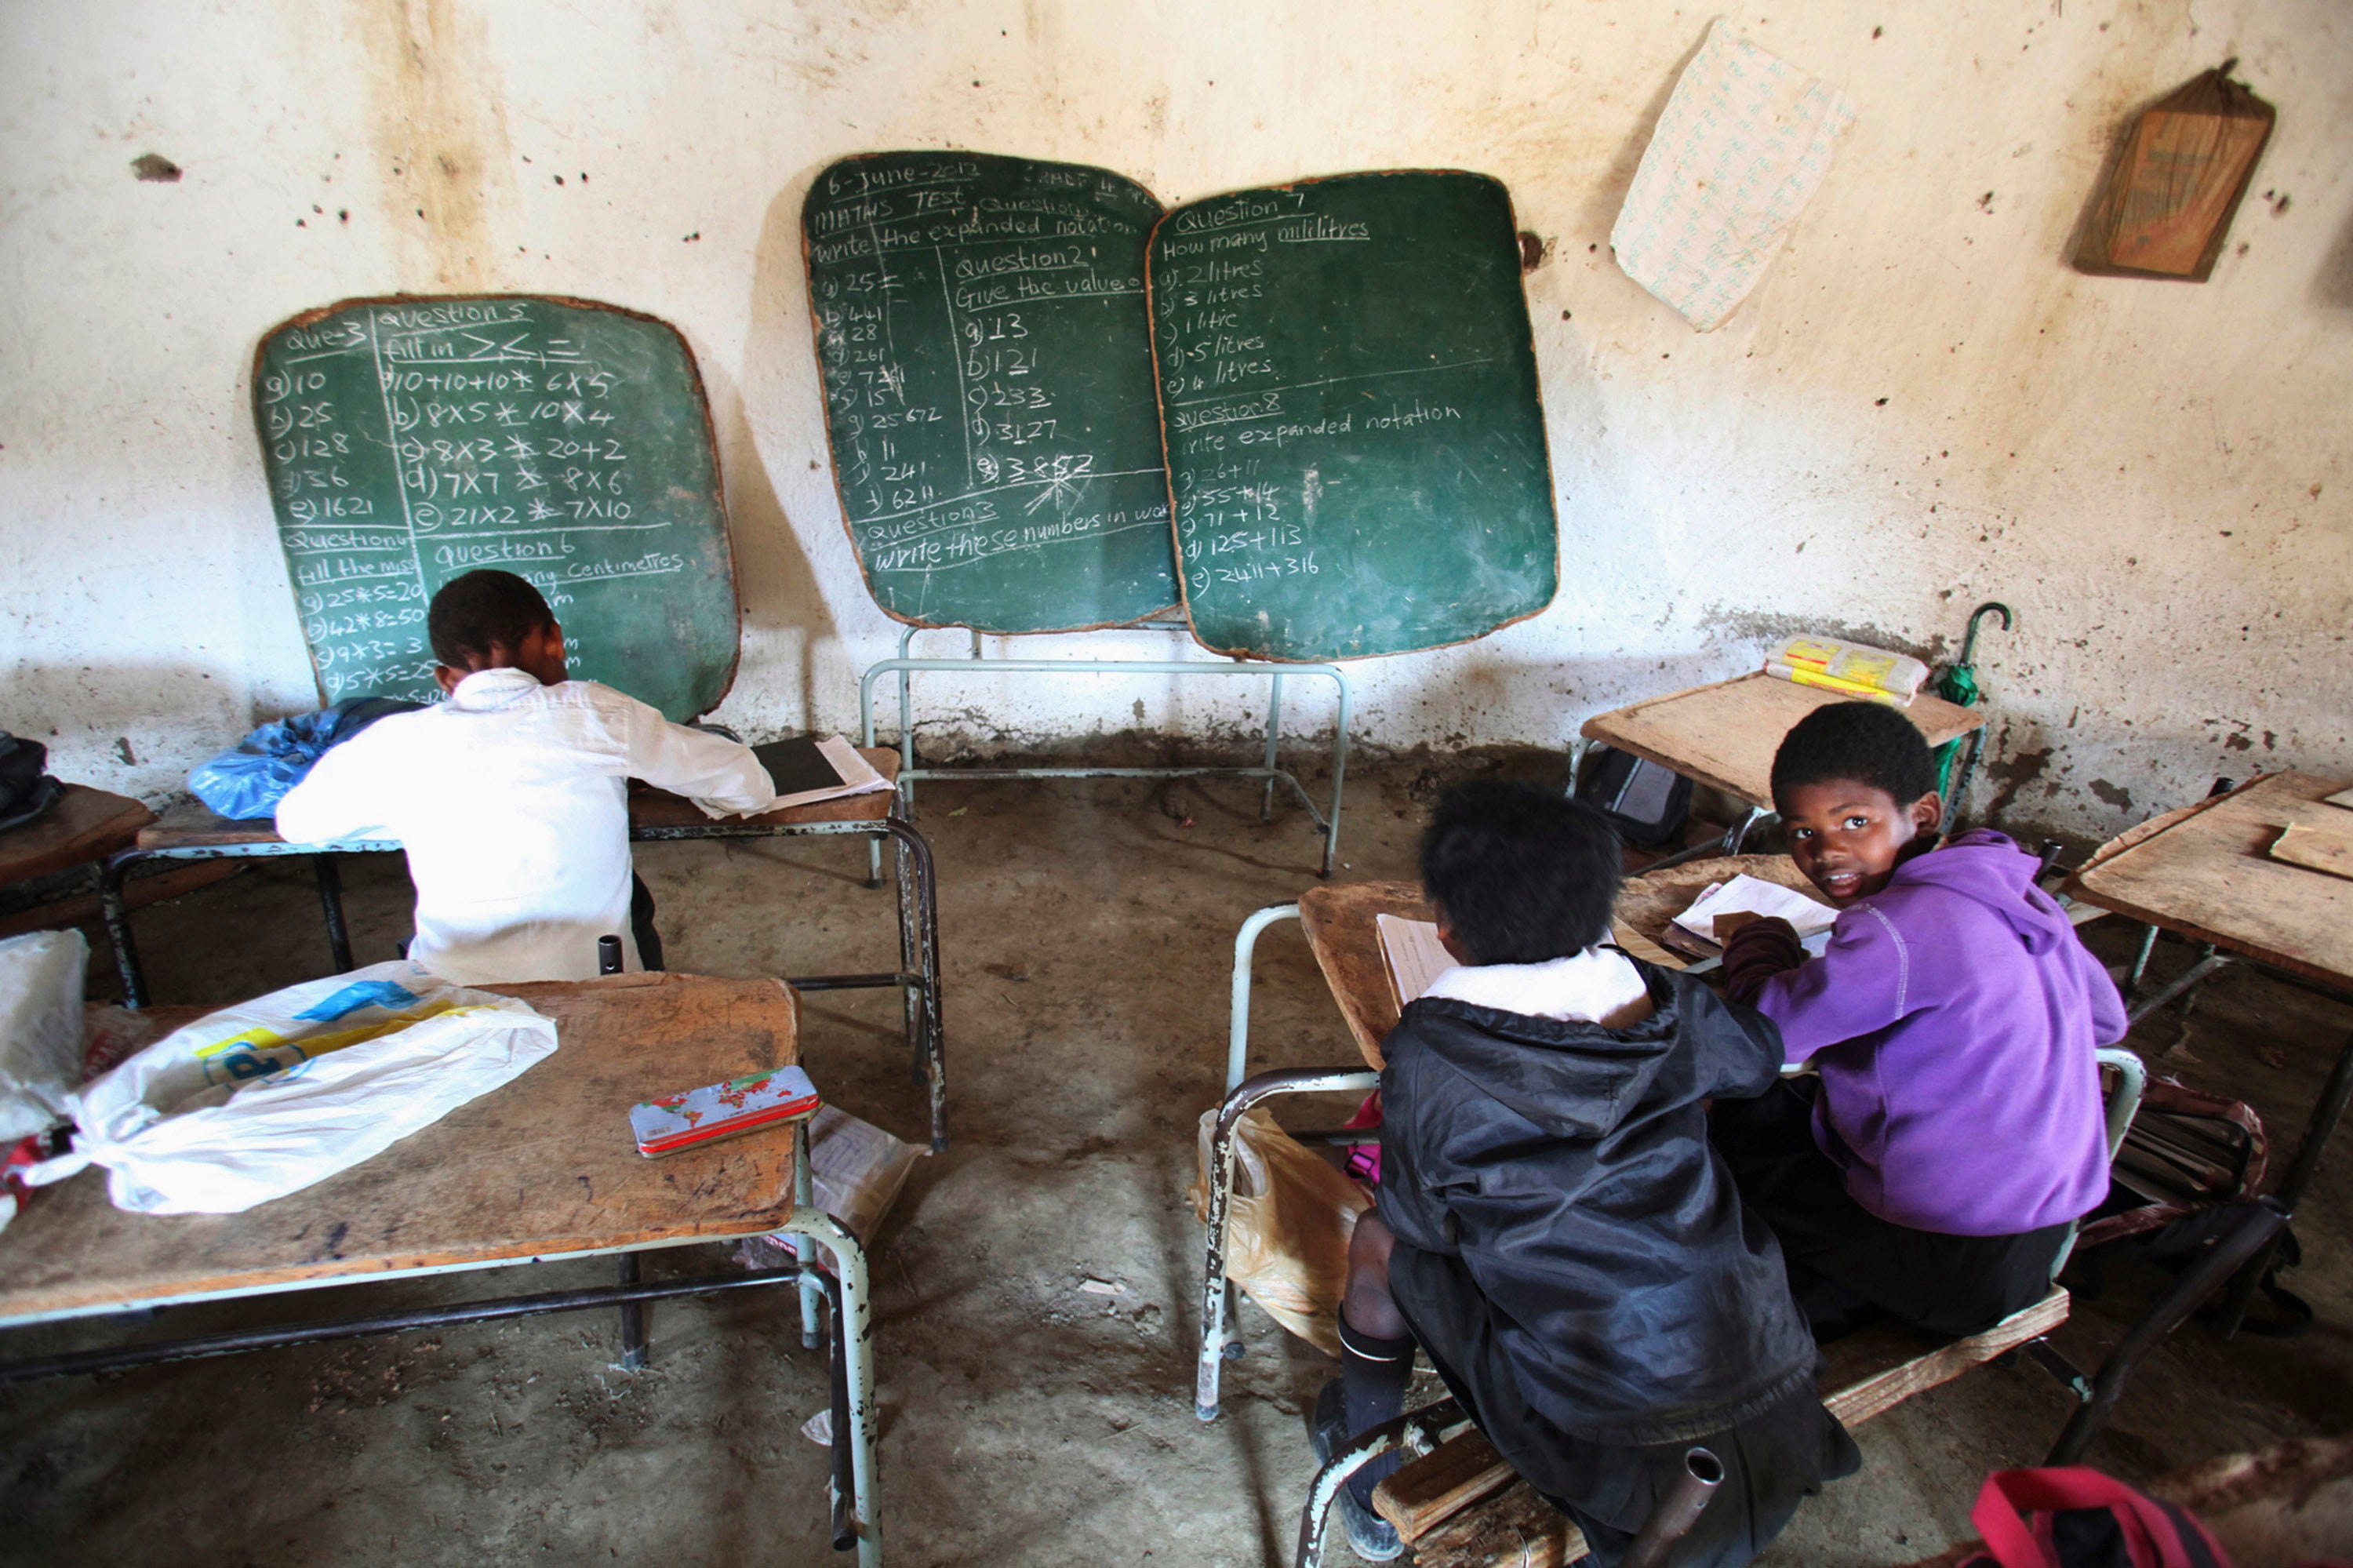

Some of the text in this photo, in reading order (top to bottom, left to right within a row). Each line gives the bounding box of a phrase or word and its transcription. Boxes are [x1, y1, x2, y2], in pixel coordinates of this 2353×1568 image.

[1176, 193, 1305, 233] Question 7
[881, 227, 921, 248] the
[1056, 215, 1137, 235] notato
[1163, 239, 1203, 260] How
[1209, 227, 1267, 252] many
[1018, 276, 1056, 298] the
[1066, 267, 1125, 293] value
[1207, 284, 1263, 304] litres
[849, 305, 882, 322] 441
[1197, 309, 1238, 330] litre
[852, 323, 877, 341] 28
[431, 341, 455, 358] in
[995, 347, 1037, 373] 121
[296, 371, 326, 395] 10
[1216, 358, 1272, 384] litres
[868, 387, 895, 408] 15
[298, 401, 335, 428] 25
[1182, 398, 1461, 455] rite expanded notation
[301, 432, 351, 458] 128
[867, 501, 998, 540] Question 3
[945, 529, 1018, 558] these
[1022, 511, 1100, 541] numbers
[1107, 511, 1126, 524] in
[435, 537, 553, 567] Question
[338, 558, 374, 577] the
